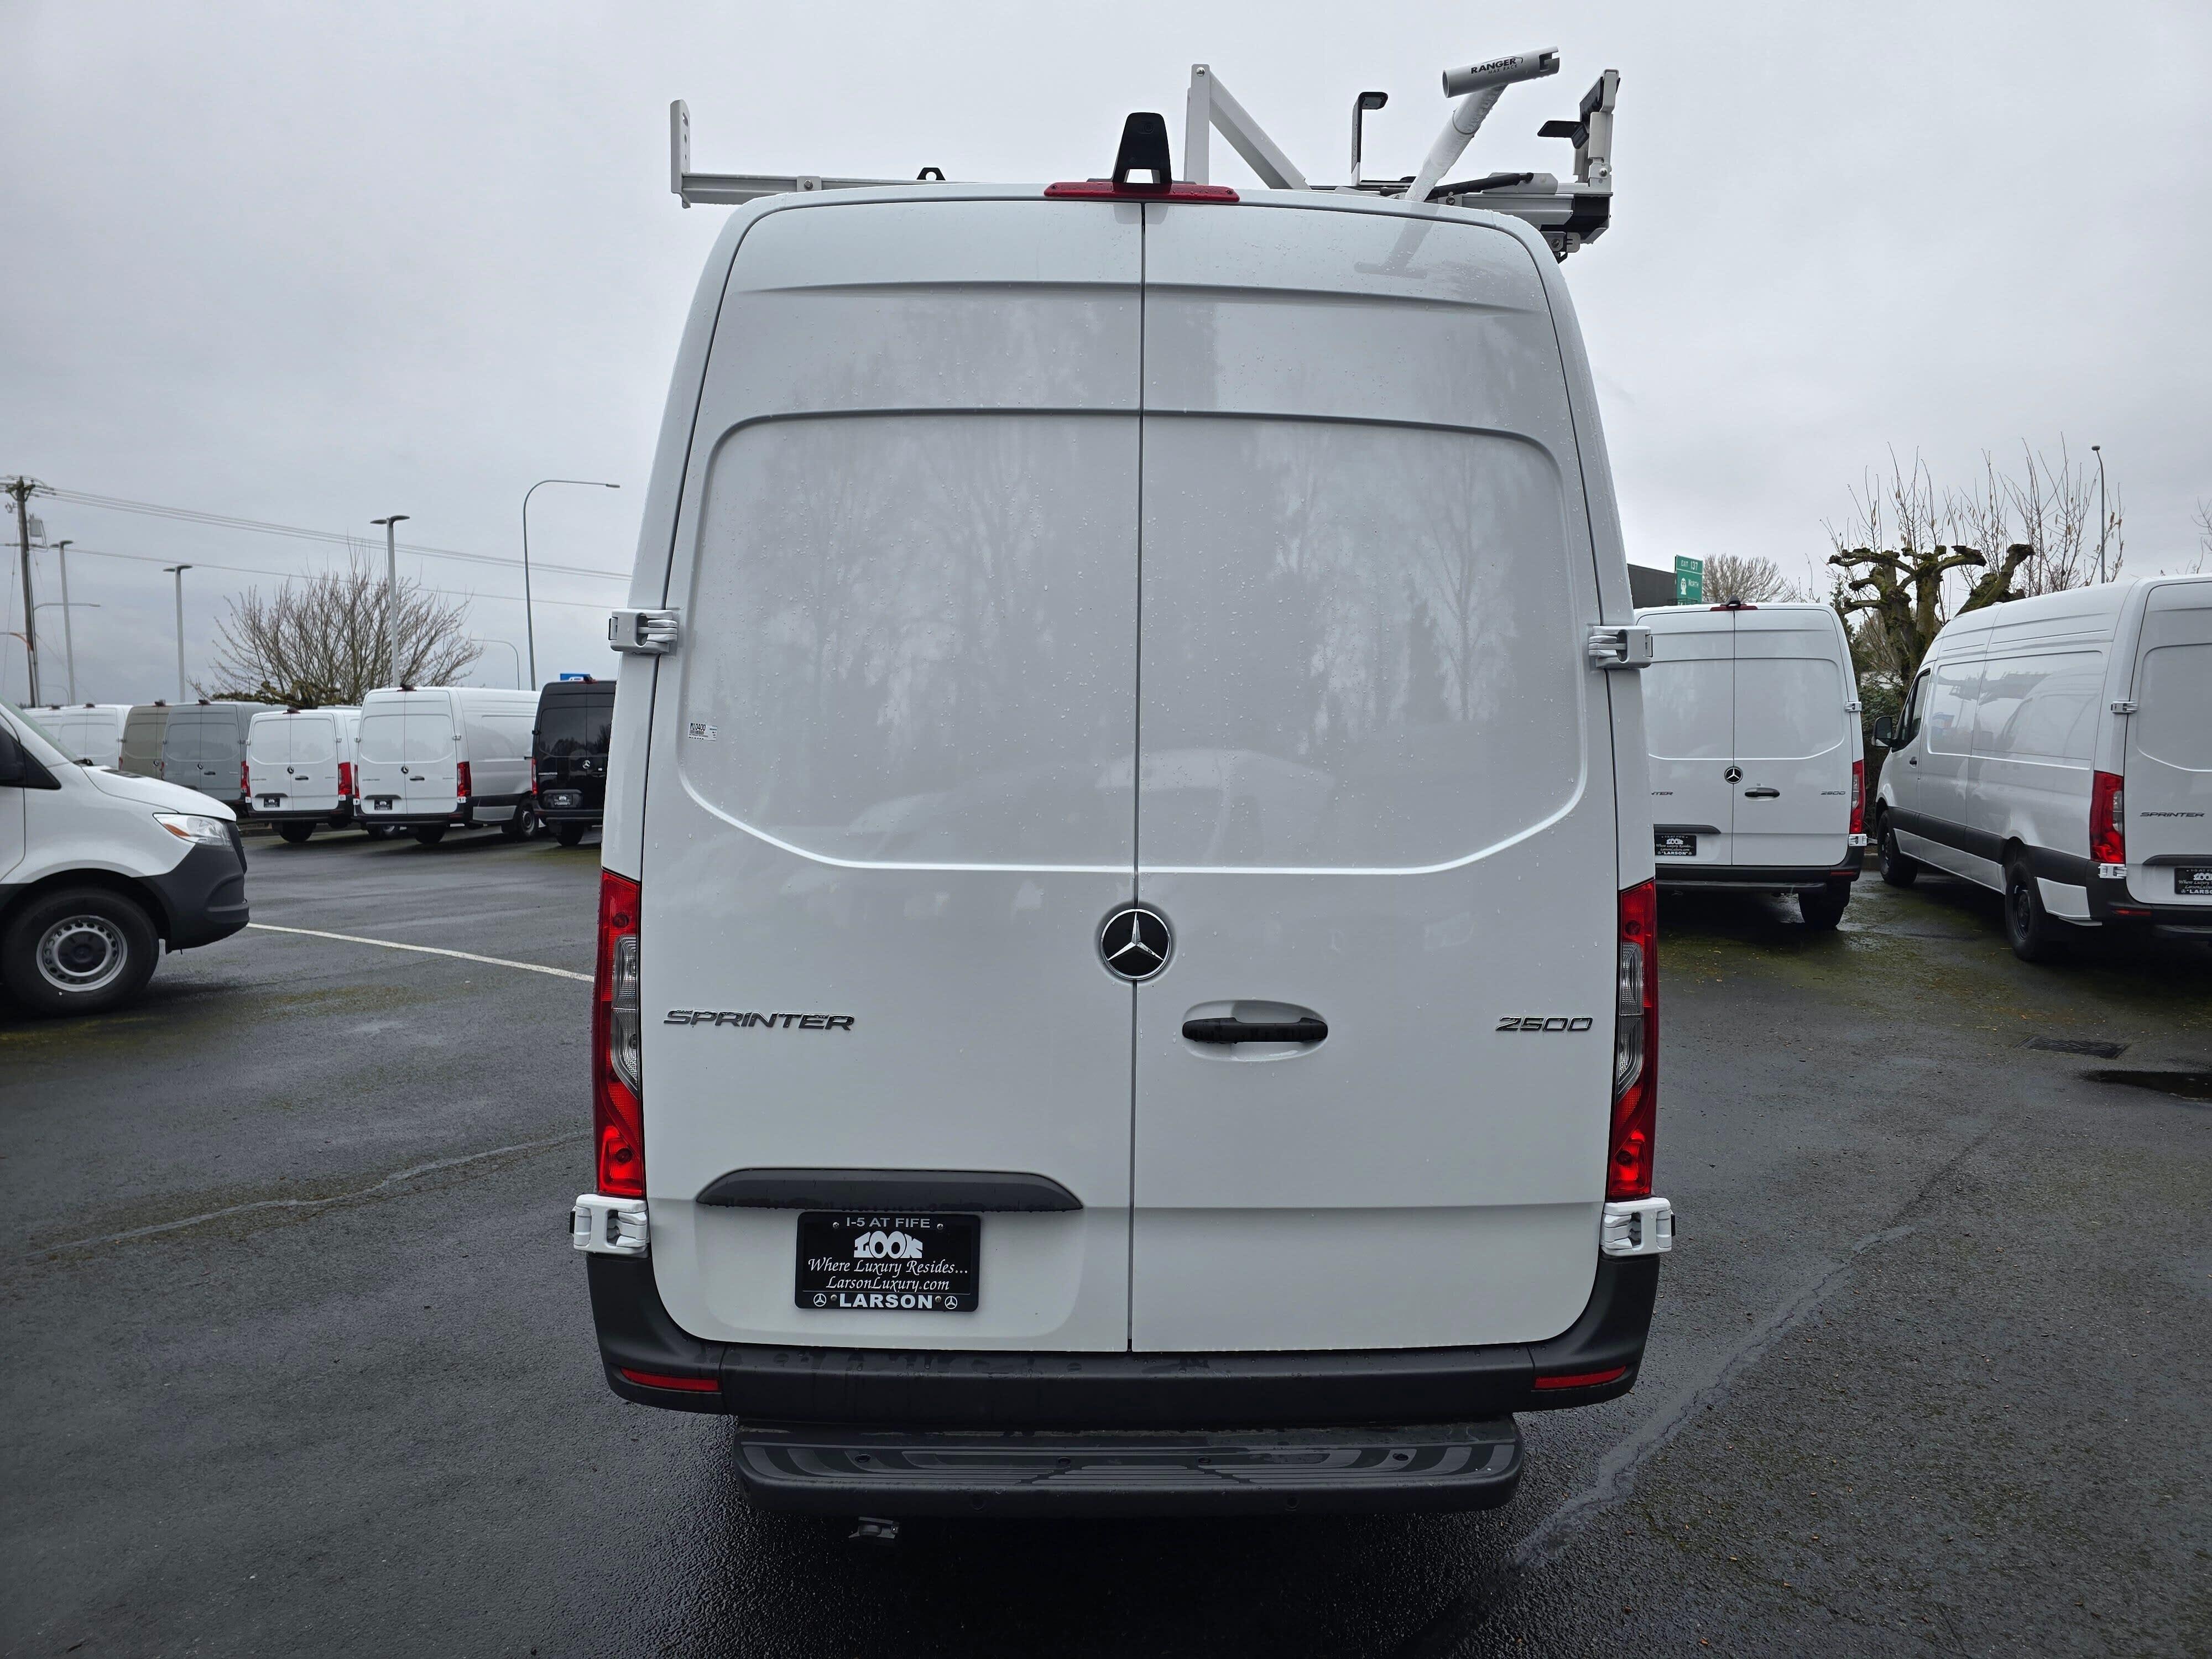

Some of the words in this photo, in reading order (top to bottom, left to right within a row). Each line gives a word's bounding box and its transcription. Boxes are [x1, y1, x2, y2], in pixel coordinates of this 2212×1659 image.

[1471, 58, 1516, 74] RANGER
[663, 1009, 855, 1031] SPRINTER
[1495, 1015, 1593, 1032] 2500
[846, 1217, 865, 1228] I-5
[869, 1217, 890, 1228] AT
[895, 1218, 931, 1228] FIFE
[853, 1230, 923, 1259] LOOK
[808, 1256, 851, 1272] Where
[853, 1259, 902, 1278] Luxury
[906, 1259, 968, 1276] Resides...
[826, 1275, 950, 1293] LarsonLuxury.com
[839, 1293, 932, 1309] LARSON
